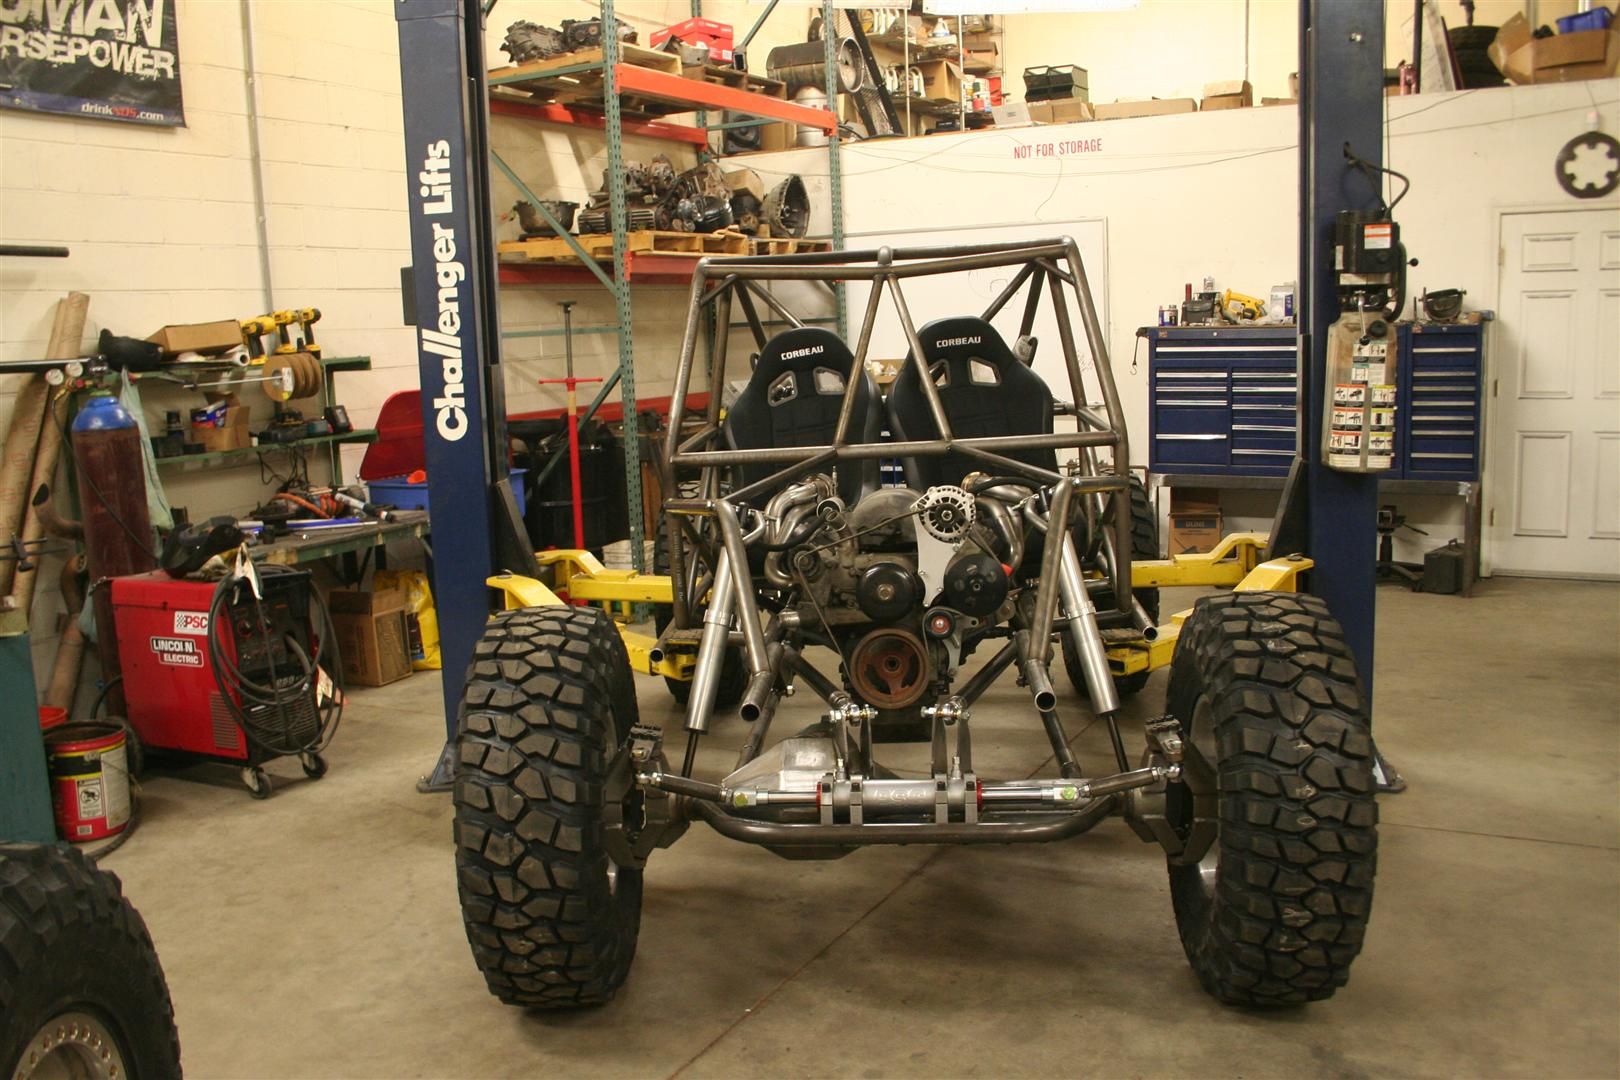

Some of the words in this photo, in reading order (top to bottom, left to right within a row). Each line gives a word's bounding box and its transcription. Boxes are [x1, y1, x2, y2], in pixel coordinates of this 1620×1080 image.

[1013, 145, 1032, 159] NOT
[1036, 143, 1054, 157] FOR
[1059, 138, 1102, 155] STORAGE
[419, 139, 453, 214] Lifts
[422, 222, 468, 441] Challenger
[936, 336, 981, 348] CORBEAU
[780, 345, 824, 361] CORBEAU
[184, 615, 208, 628] PSC
[153, 639, 193, 653] LINCOLN
[163, 653, 199, 664] ELECTRIC
